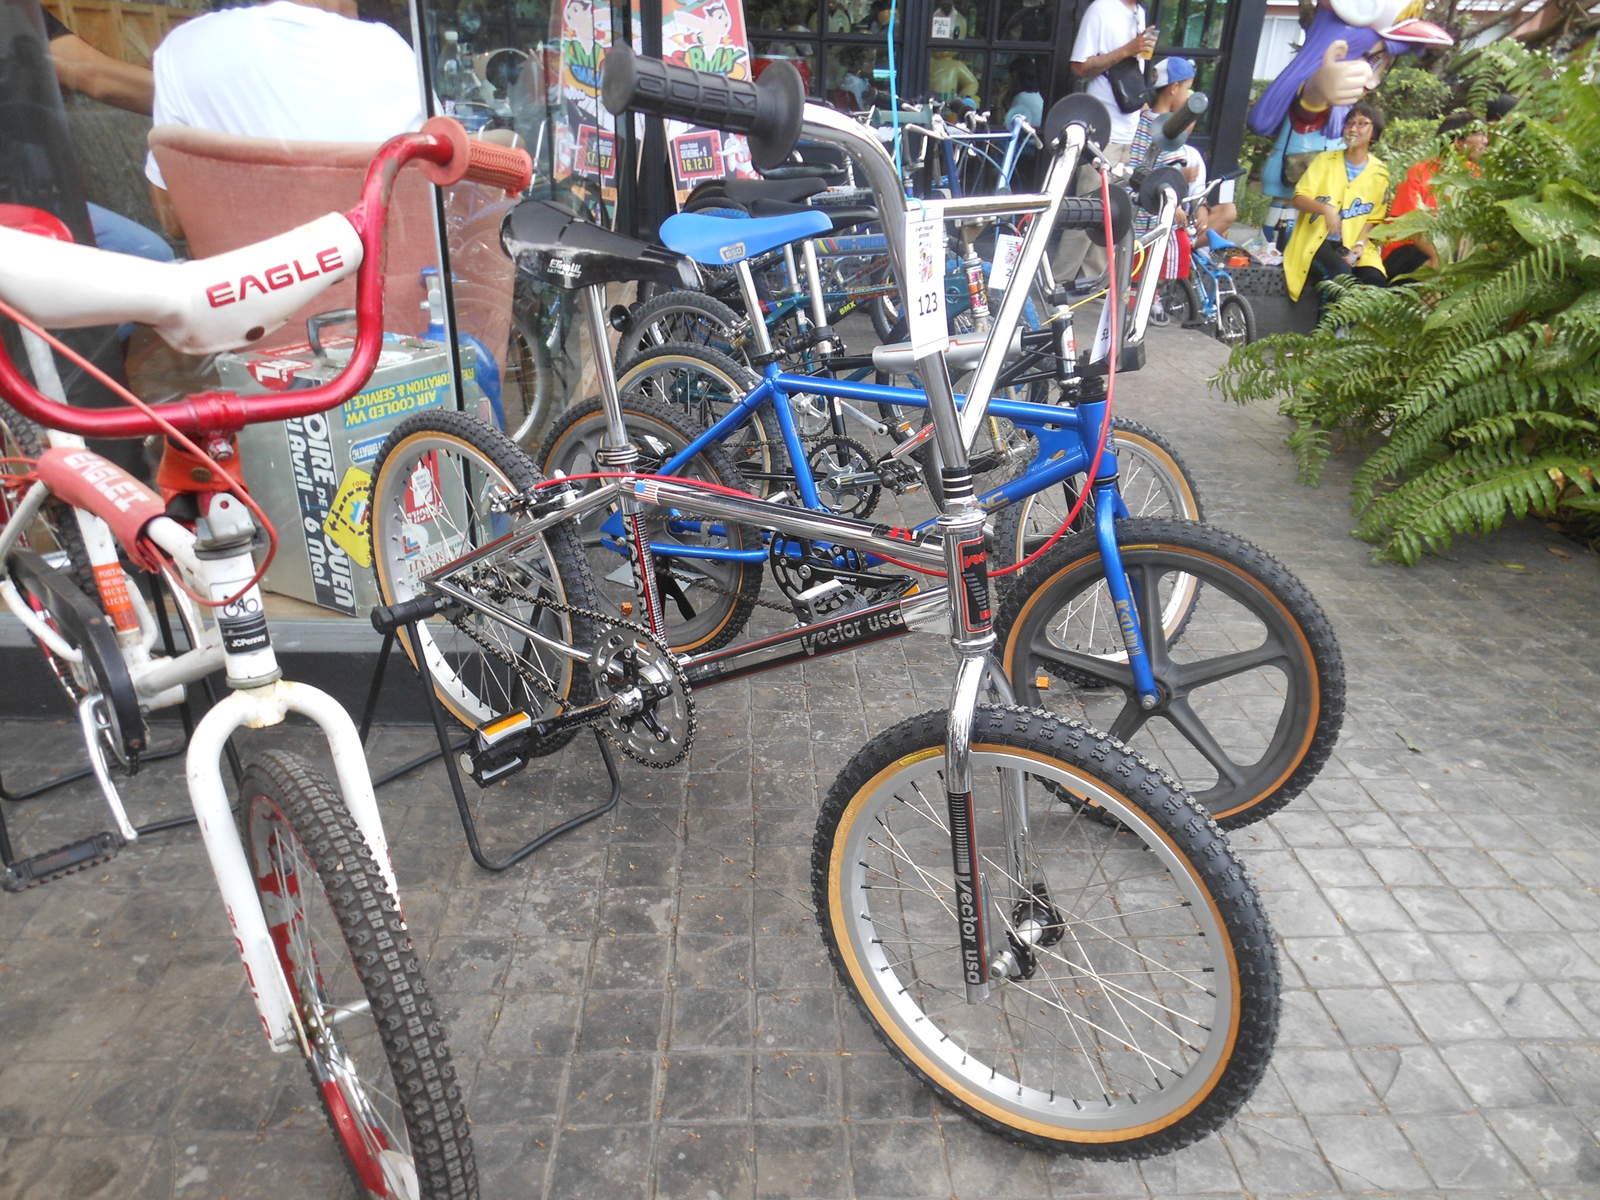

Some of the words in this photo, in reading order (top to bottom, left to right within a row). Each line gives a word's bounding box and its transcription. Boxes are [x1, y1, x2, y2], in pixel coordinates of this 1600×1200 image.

[687, 45, 746, 73] BMX
[205, 246, 344, 308] EAGLE
[918, 291, 938, 316] 123
[352, 387, 396, 408] SERVICE
[396, 384, 406, 396] &
[417, 389, 436, 405] AIR
[345, 410, 368, 427] VW
[368, 397, 415, 418] COOLED
[303, 412, 336, 487] OIRE
[316, 487, 328, 508] DE
[304, 516, 321, 533] 6
[307, 537, 331, 588] Mai
[231, 634, 266, 648] JCPenney
[801, 617, 862, 656] Vector
[868, 609, 902, 634] usa
[954, 873, 977, 945] Vector
[965, 948, 981, 984] usa
